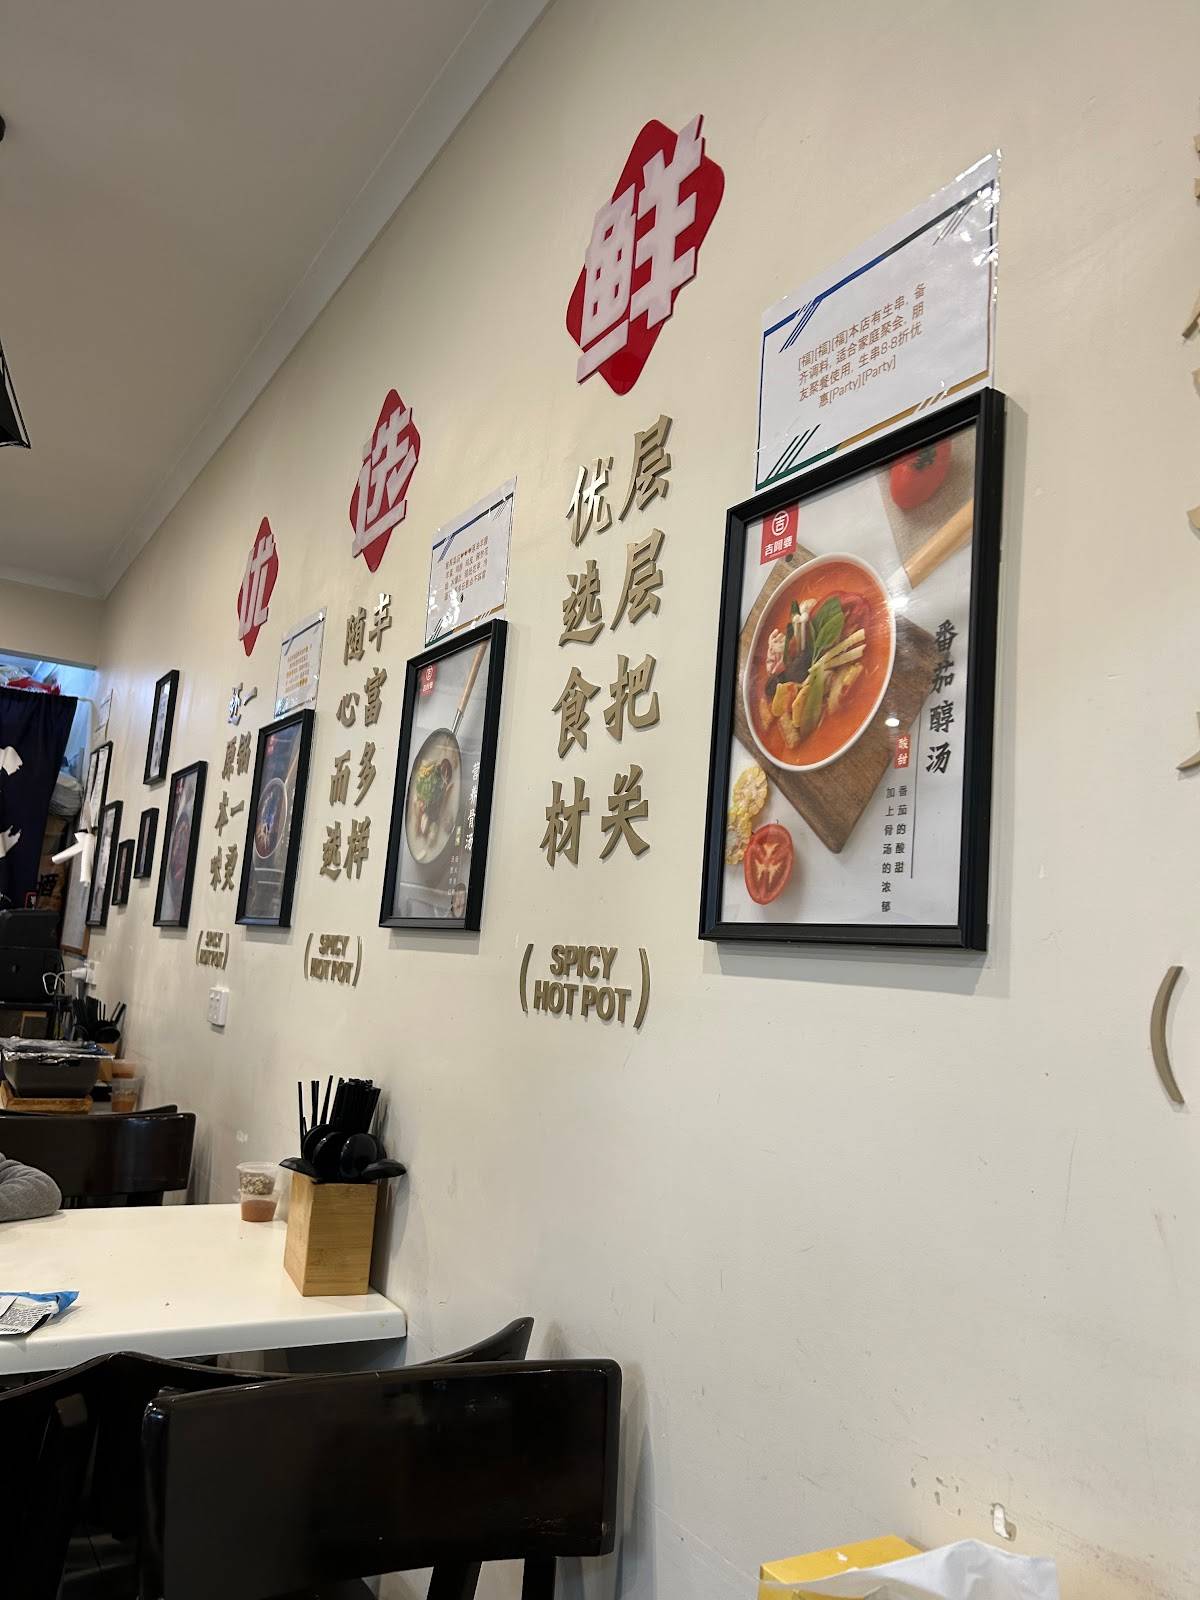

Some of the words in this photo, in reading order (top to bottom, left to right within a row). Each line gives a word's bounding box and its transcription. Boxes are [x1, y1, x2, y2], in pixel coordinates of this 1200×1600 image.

[576, 114, 705, 384] 鲜
[352, 406, 418, 558] 选
[239, 533, 276, 641] 优
[539, 456, 614, 868] 优选食材
[599, 414, 673, 860] 层层把关
[926, 619, 958, 774] 番茄醇汤
[533, 980, 579, 1016] HOT
[581, 985, 632, 1024] POT
[550, 944, 618, 980] SPICY
